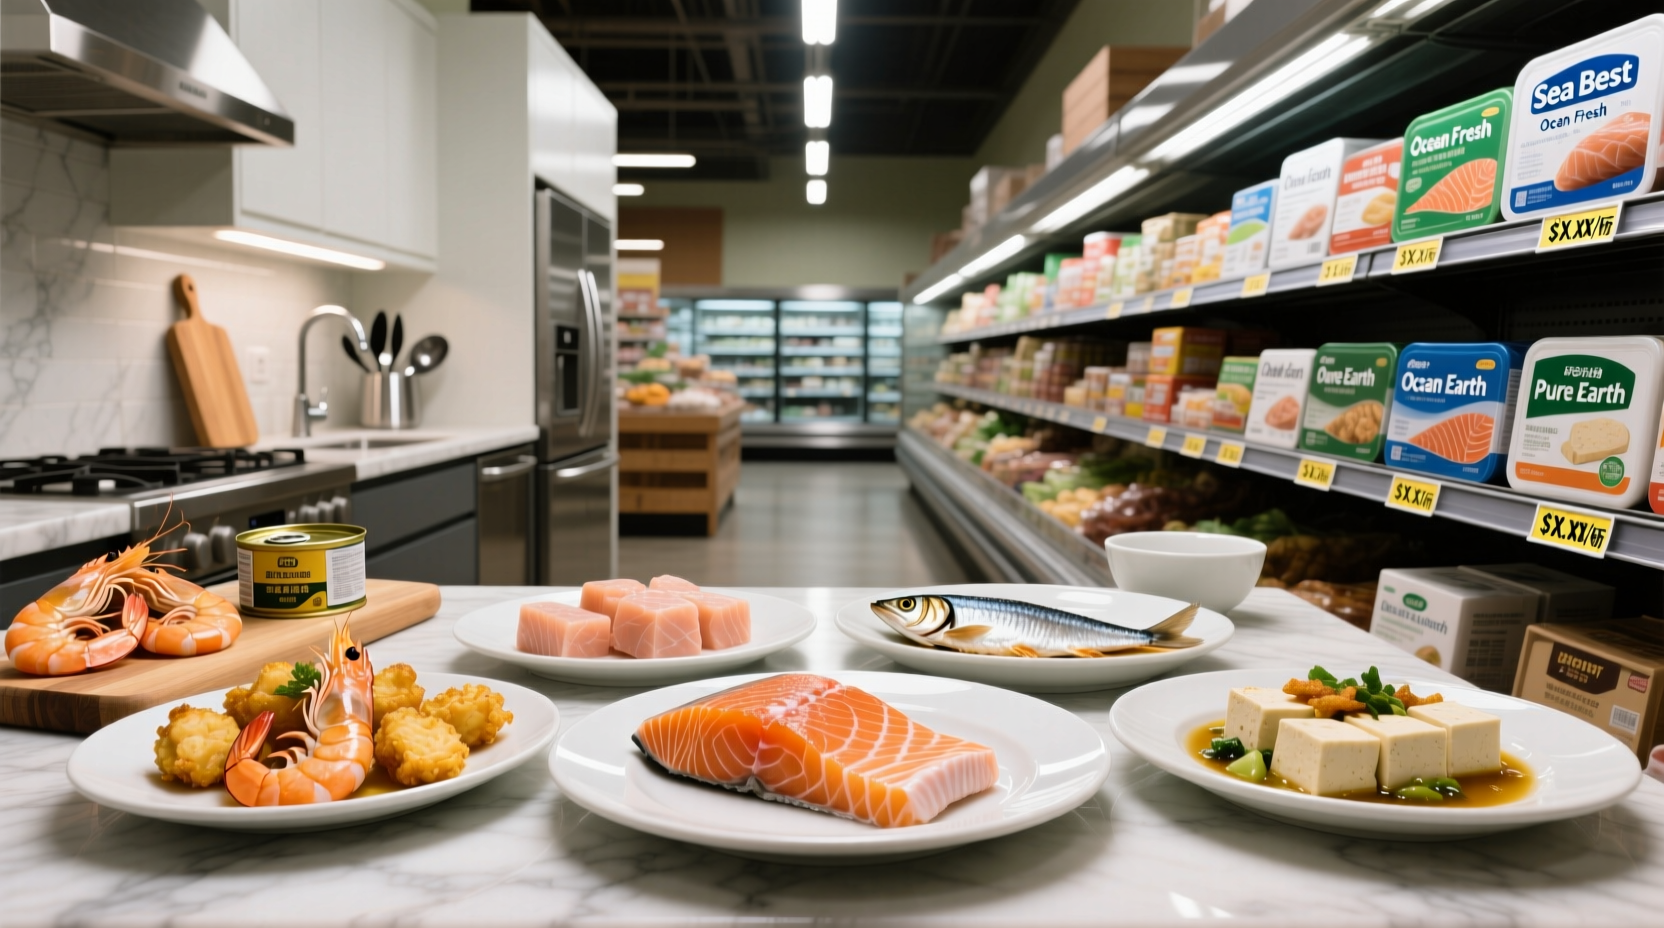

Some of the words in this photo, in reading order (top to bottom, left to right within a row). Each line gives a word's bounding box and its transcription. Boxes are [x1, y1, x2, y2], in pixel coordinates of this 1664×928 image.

[1533, 81, 1574, 109] Sea
[1578, 60, 1633, 97] Best
[1451, 118, 1492, 147] Fresh
[1343, 367, 1375, 387] Earth
[1444, 374, 1487, 397] Earth
[1534, 378, 1574, 401] Pure
[1576, 382, 1626, 404] Earth
